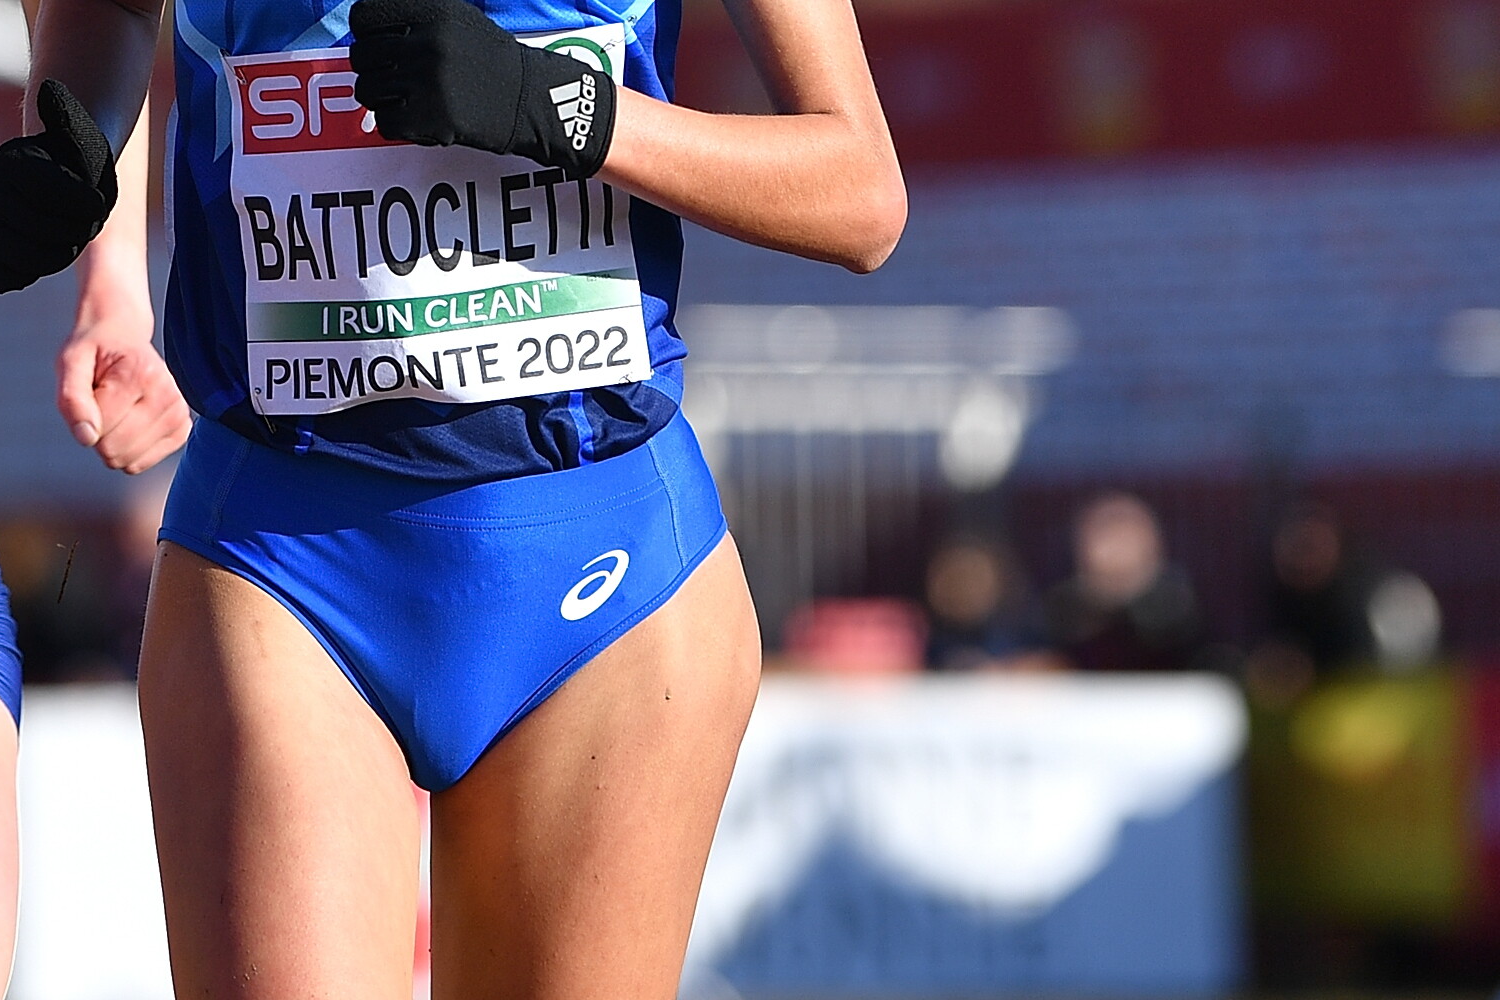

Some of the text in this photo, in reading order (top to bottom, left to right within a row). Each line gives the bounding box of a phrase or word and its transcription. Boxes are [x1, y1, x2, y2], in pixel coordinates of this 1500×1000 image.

[248, 71, 378, 140] SP
[572, 73, 596, 151] adidas
[243, 168, 615, 282] BATTOCLETTI
[322, 306, 329, 335] I
[339, 302, 414, 335] RUN
[265, 326, 632, 400] PIEMONTE 2022
